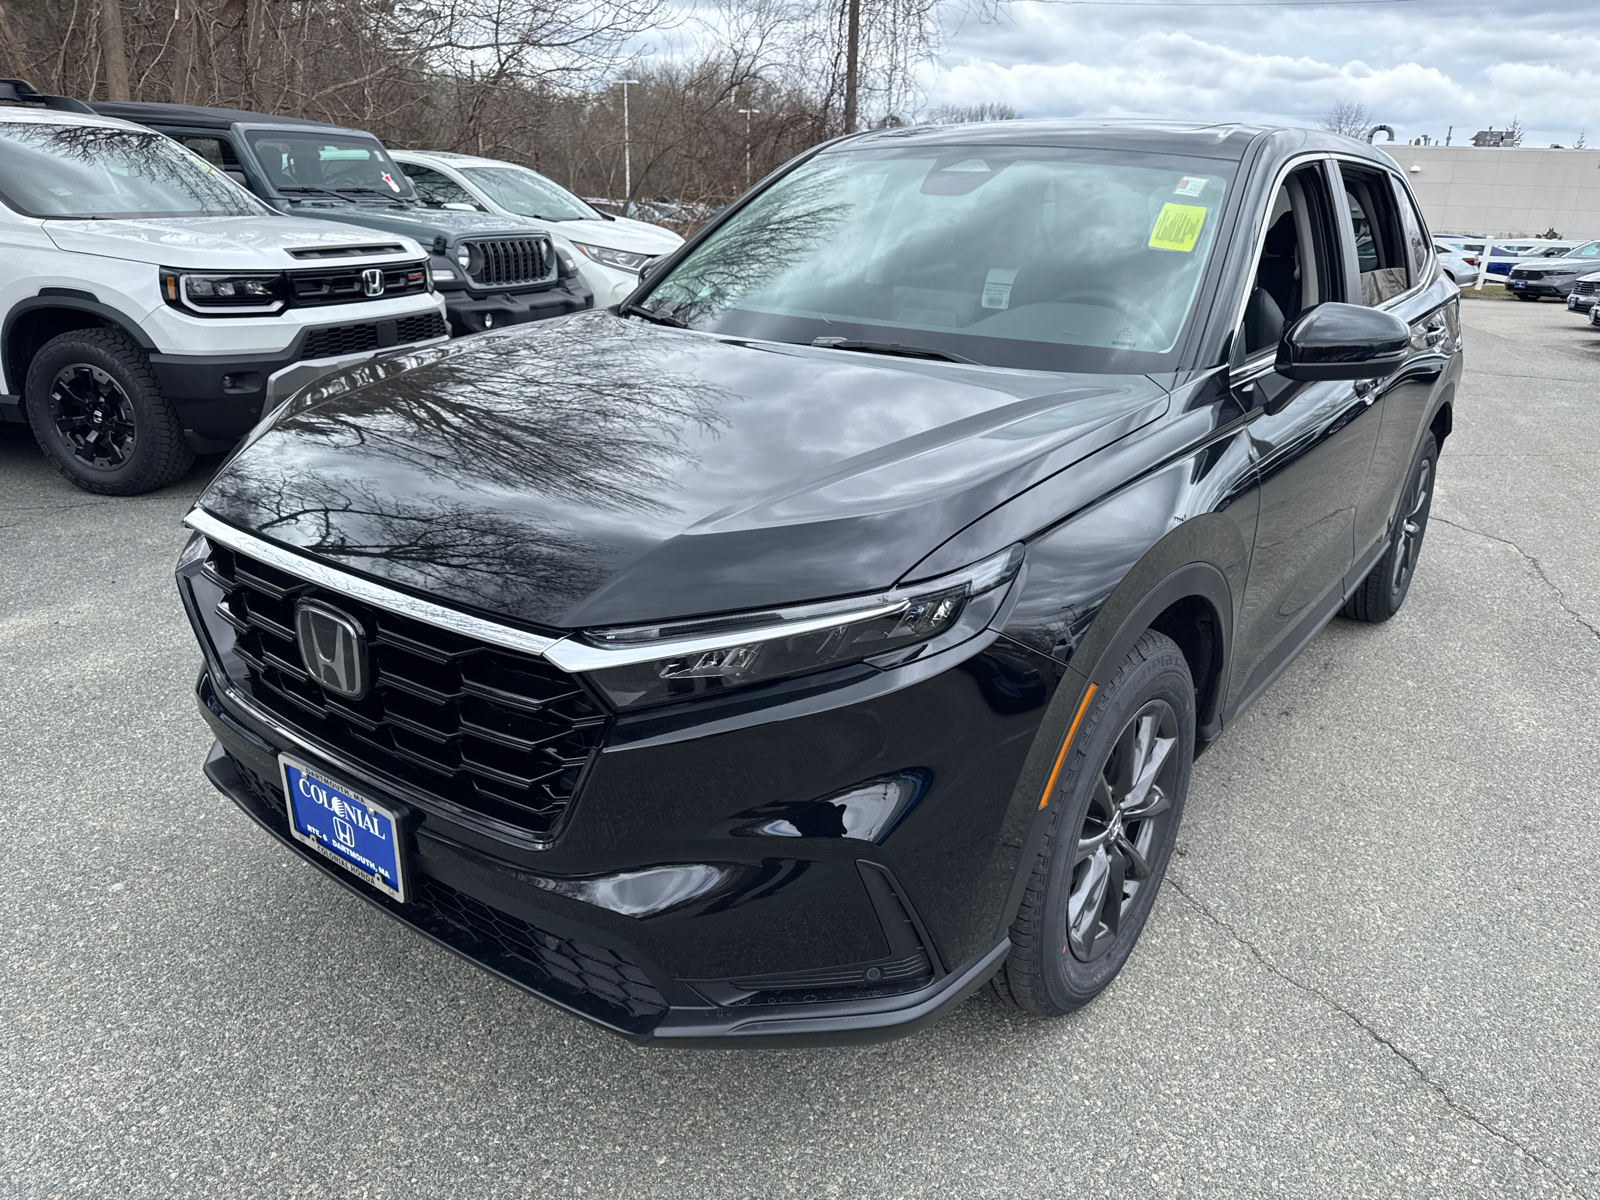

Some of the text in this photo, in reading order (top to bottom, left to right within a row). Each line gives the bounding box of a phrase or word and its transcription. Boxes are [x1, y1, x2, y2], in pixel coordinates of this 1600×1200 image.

[299, 778, 385, 840] COLONIAL
[353, 792, 366, 804] MA
[317, 845, 375, 885] COLONIAL HONDA
[331, 839, 377, 873] DARTMOUTH,
[378, 866, 390, 879] MA
